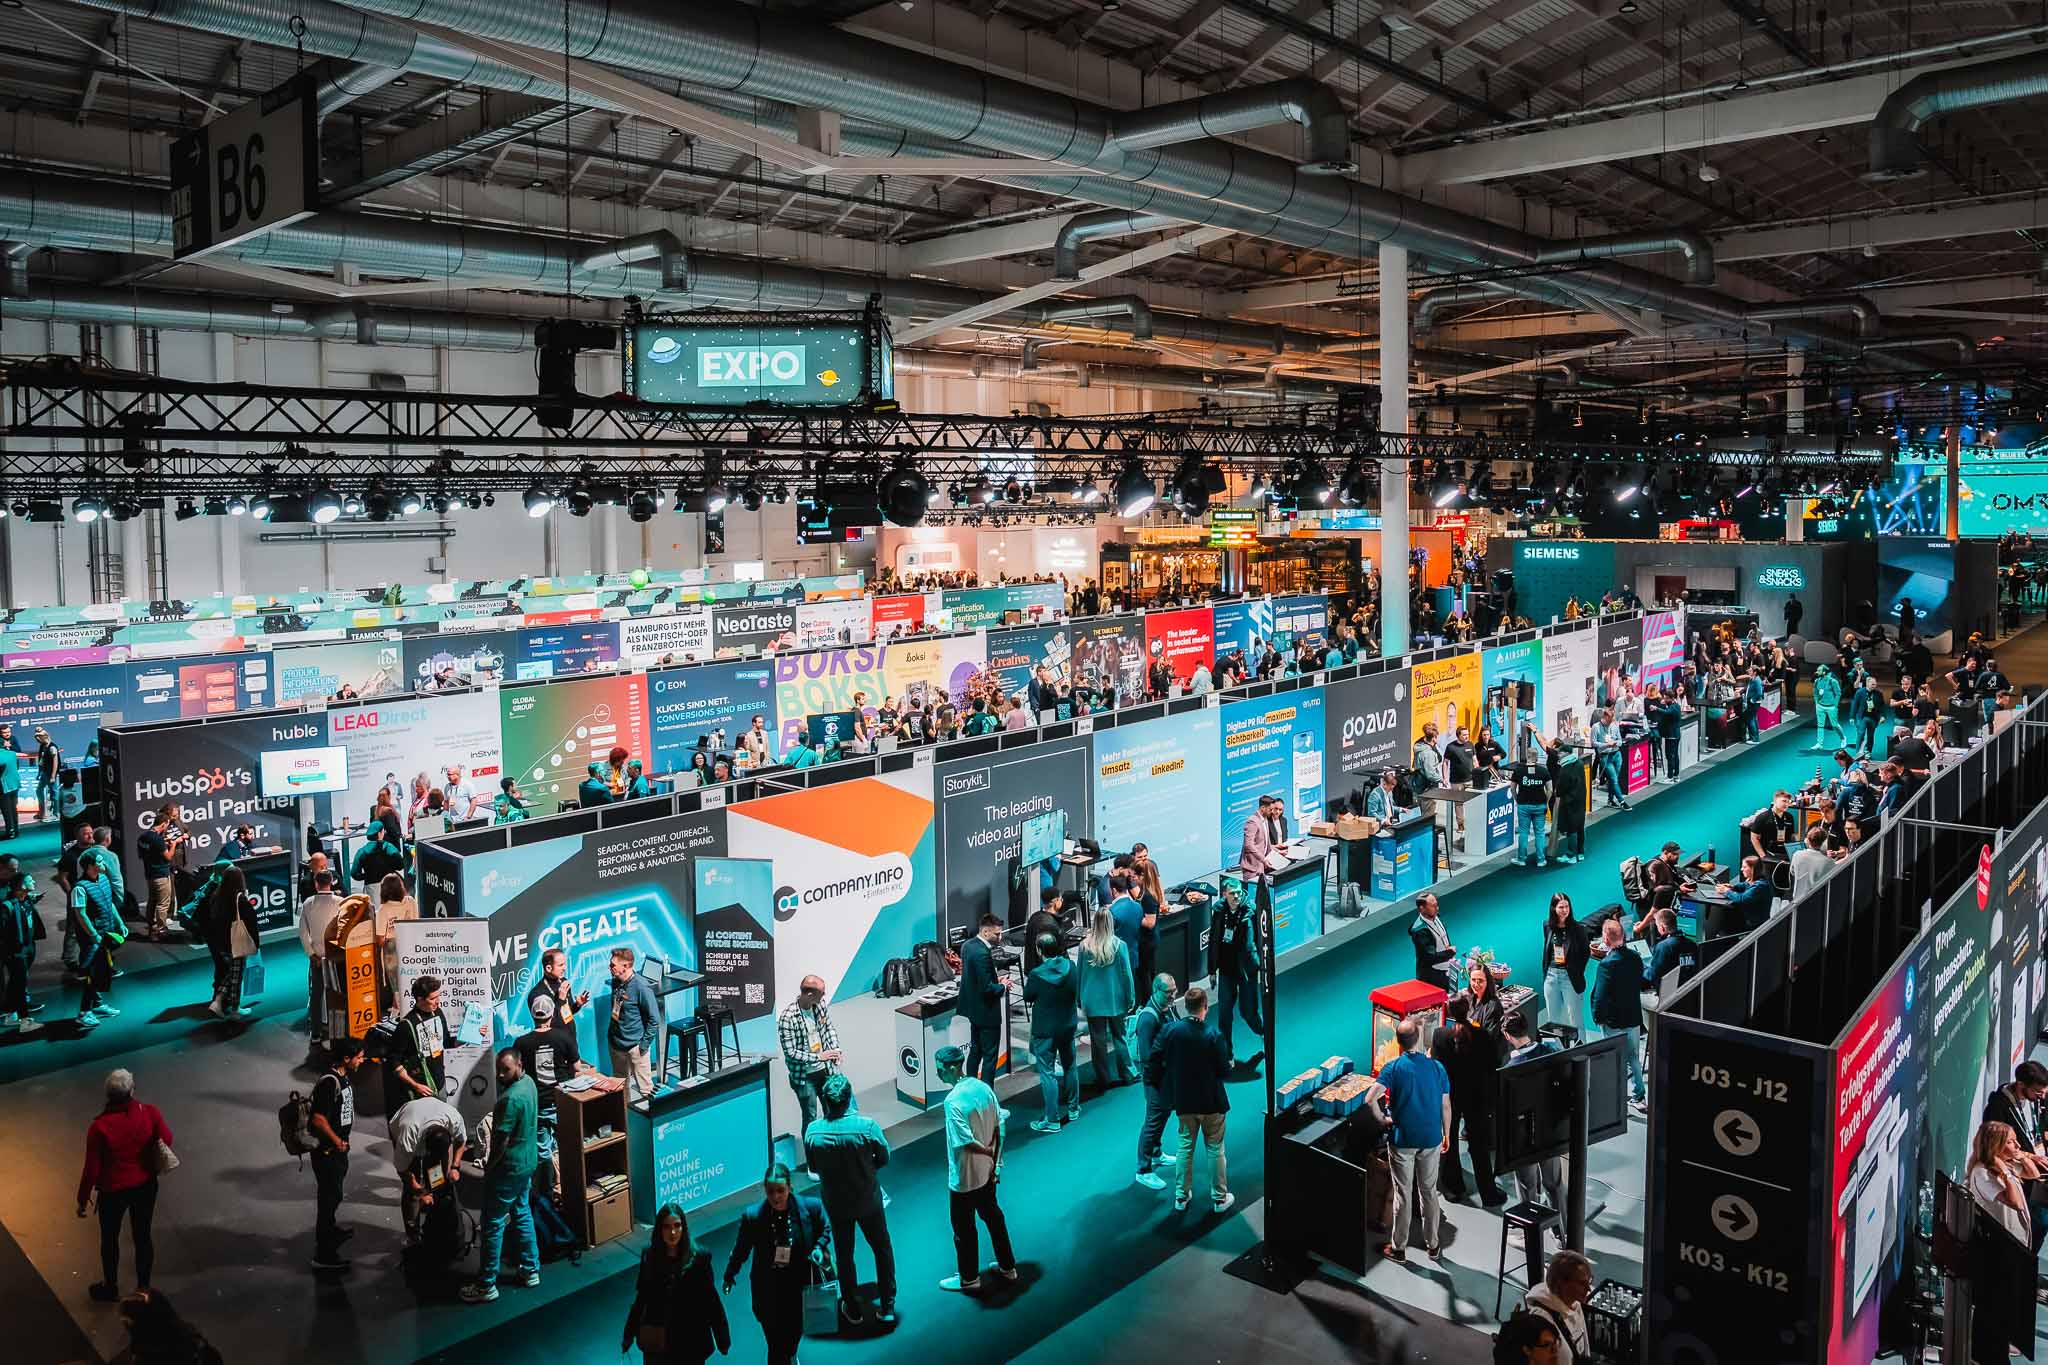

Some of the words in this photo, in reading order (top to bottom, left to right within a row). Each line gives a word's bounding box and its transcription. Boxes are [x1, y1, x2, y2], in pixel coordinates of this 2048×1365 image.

[218, 133, 265, 232] B6
[703, 351, 799, 380] EXPO
[1524, 547, 1579, 559] SIEMENS
[1759, 576, 1802, 586] &SNACKS
[1766, 568, 1799, 578] SNEAKS
[476, 601, 507, 609] INNOVATOR
[946, 603, 984, 614] amification
[717, 613, 793, 634] NeoTaste
[952, 613, 977, 623] arketing
[978, 610, 999, 620] Builder
[60, 629, 104, 637] INNOVATOR
[628, 624, 669, 634] HAMBURG
[671, 622, 683, 630] IST
[684, 620, 705, 628] MEHR
[1179, 627, 1198, 637] leader
[626, 635, 641, 643] ALS
[642, 633, 659, 642] NUR
[1174, 637, 1191, 646] social
[1192, 635, 1209, 644] media
[1167, 646, 1204, 657] performance
[1505, 648, 1531, 661] AIRSHIP
[668, 680, 686, 690] EOM
[35, 692, 54, 701] die
[57, 688, 119, 700] Kund:innen
[512, 696, 536, 705] GLOBAL
[39, 703, 61, 712] und
[64, 700, 103, 710] binden
[512, 704, 534, 712] GROUP
[656, 703, 685, 714] KLICKS
[686, 700, 706, 710] SIND
[708, 697, 730, 706] NETT.
[657, 708, 715, 723] CONVERSIONS
[717, 705, 735, 714] SIND
[737, 701, 768, 711] BESSER.
[1226, 719, 1247, 732] Digital
[1248, 717, 1256, 727] PR
[1256, 715, 1265, 726] für
[1266, 709, 1296, 722] maximale
[272, 724, 318, 742] huble
[1226, 729, 1264, 746] Sichtbarkeit
[1271, 723, 1292, 737] Google
[1226, 748, 1240, 759] und
[1241, 746, 1251, 757] der
[1258, 740, 1279, 752] Search
[1343, 752, 1353, 762] Hier
[1353, 747, 1370, 760] spricht
[1378, 740, 1396, 752] Zukunft
[1102, 761, 1130, 776] Umsatz
[1151, 759, 1184, 776] LinkedIn?
[1343, 761, 1353, 771] Und
[1371, 754, 1383, 766] sogar
[135, 768, 252, 800] HubSpot's
[138, 800, 213, 830] Gbal
[220, 794, 295, 817] Partner
[984, 805, 1007, 823] The
[1011, 795, 1053, 817] leading
[597, 840, 630, 856] SEARCH.
[632, 834, 668, 849] CONTENT.
[670, 825, 710, 841] OUTREACH.
[967, 828, 1001, 849] video
[598, 849, 657, 867] PERFORMANCE.
[658, 843, 688, 855] SOCIAL.
[689, 836, 714, 848] BRAND.
[598, 862, 637, 879] TRACKING
[638, 861, 645, 870] &
[646, 852, 686, 869] ANALYTICS.
[426, 871, 438, 888] H02
[443, 880, 455, 895] H12
[803, 867, 903, 905] COMPANY.INFO
[489, 932, 528, 967] WE
[538, 906, 639, 950] CREATE
[705, 931, 714, 939] AI
[716, 931, 752, 940] CONTENT
[415, 944, 470, 954] Dominating
[402, 956, 436, 965] Google
[438, 955, 483, 966] Shopping
[1935, 937, 1975, 998] Datenschutz-
[351, 963, 372, 980] 30
[400, 967, 418, 976] Ads
[421, 966, 441, 975] with
[443, 968, 464, 976] your
[447, 977, 477, 987] Digital
[452, 988, 485, 996] Brands
[1934, 981, 1964, 1037] gerechter
[1964, 949, 1986, 991] Chatbot
[354, 1008, 373, 1024] 76
[1690, 1063, 1730, 1088] J03
[1753, 1077, 1788, 1102] J12
[1840, 1109, 1861, 1152] Texte
[1861, 1089, 1872, 1116] für
[1873, 1057, 1896, 1103] deinen
[1896, 1033, 1912, 1068] Shop
[658, 1148, 689, 1168] YOUR
[660, 1158, 700, 1183] ONLINE
[660, 1163, 725, 1198] MARKETING
[1680, 1242, 1725, 1272] K03
[1748, 1263, 1790, 1292] K12
